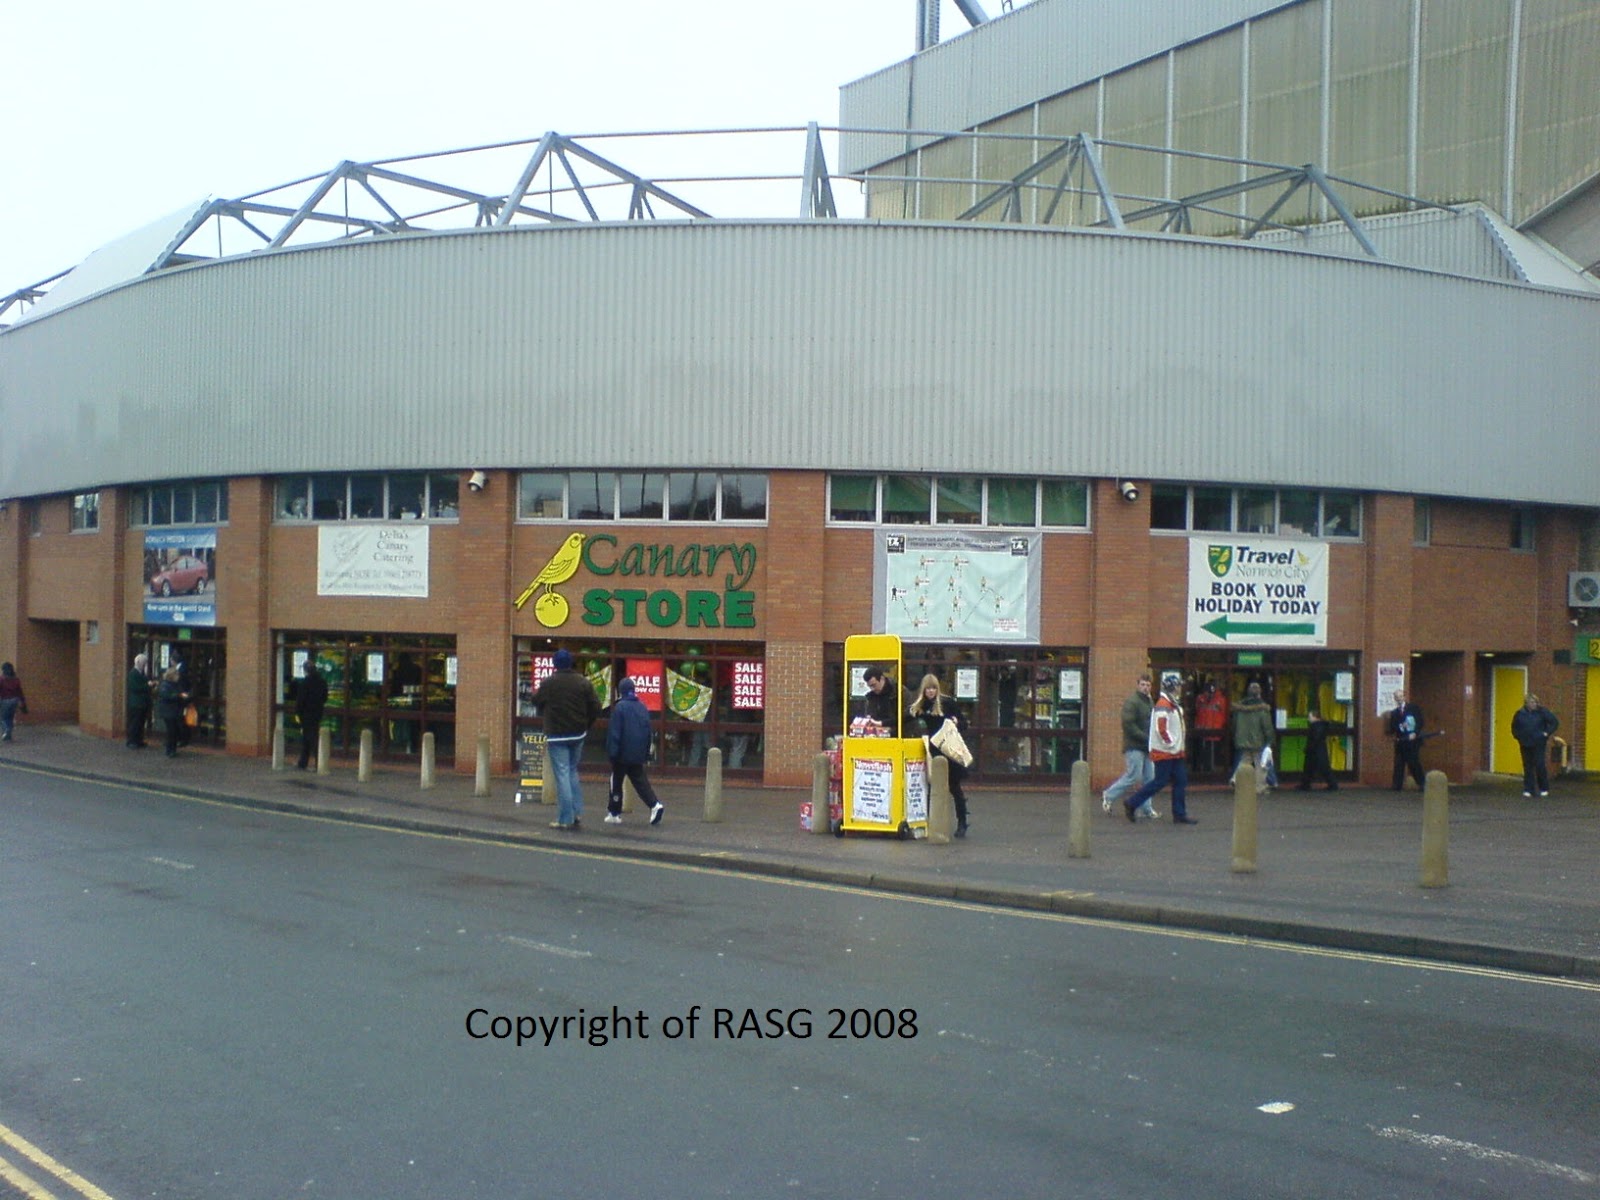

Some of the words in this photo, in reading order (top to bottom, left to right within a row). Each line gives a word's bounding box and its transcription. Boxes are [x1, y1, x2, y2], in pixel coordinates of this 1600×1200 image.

[582, 533, 757, 591] Canary
[1236, 546, 1295, 565] Travel
[1236, 564, 1282, 578] Norwich
[1284, 565, 1310, 581] City
[1211, 581, 1257, 597] BOOK
[1264, 583, 1307, 598] YOUR
[581, 588, 756, 628] STORE
[1195, 598, 1263, 613] HOLIDAY
[1270, 600, 1321, 614] TODAY
[534, 657, 555, 667] SAL
[735, 662, 763, 673] SALE
[735, 673, 763, 684] SALE
[734, 685, 762, 696] SALE
[734, 696, 762, 707] SALE
